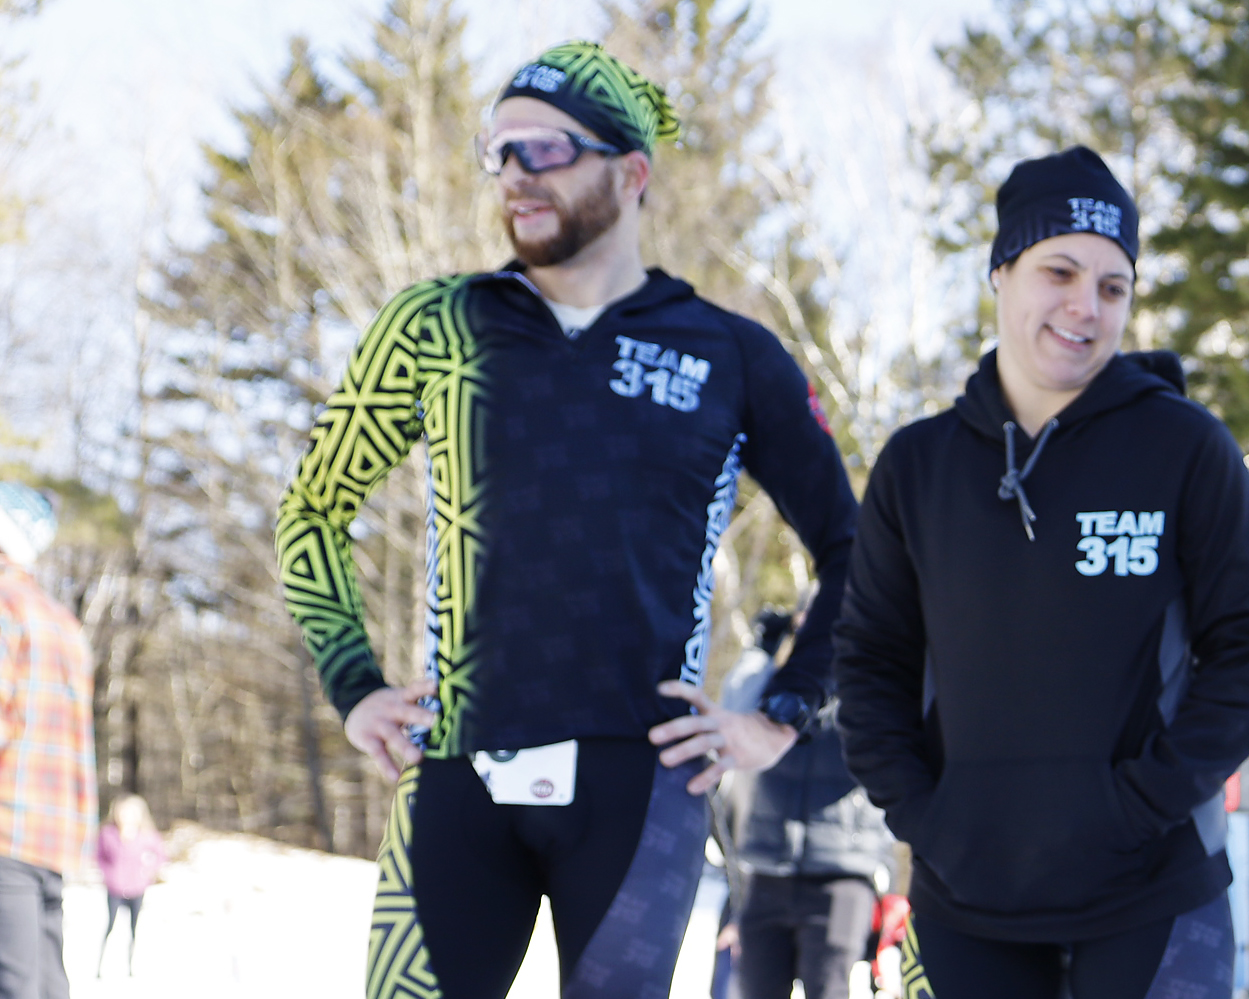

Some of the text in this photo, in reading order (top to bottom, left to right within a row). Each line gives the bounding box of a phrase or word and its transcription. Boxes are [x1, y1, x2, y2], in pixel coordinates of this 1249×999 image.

[1067, 198, 1122, 218] TEAM
[1070, 210, 1121, 238] 315
[615, 334, 711, 385] TEAM
[608, 358, 701, 412] 315
[1076, 510, 1165, 537] TEAM
[1075, 535, 1159, 576] 315
